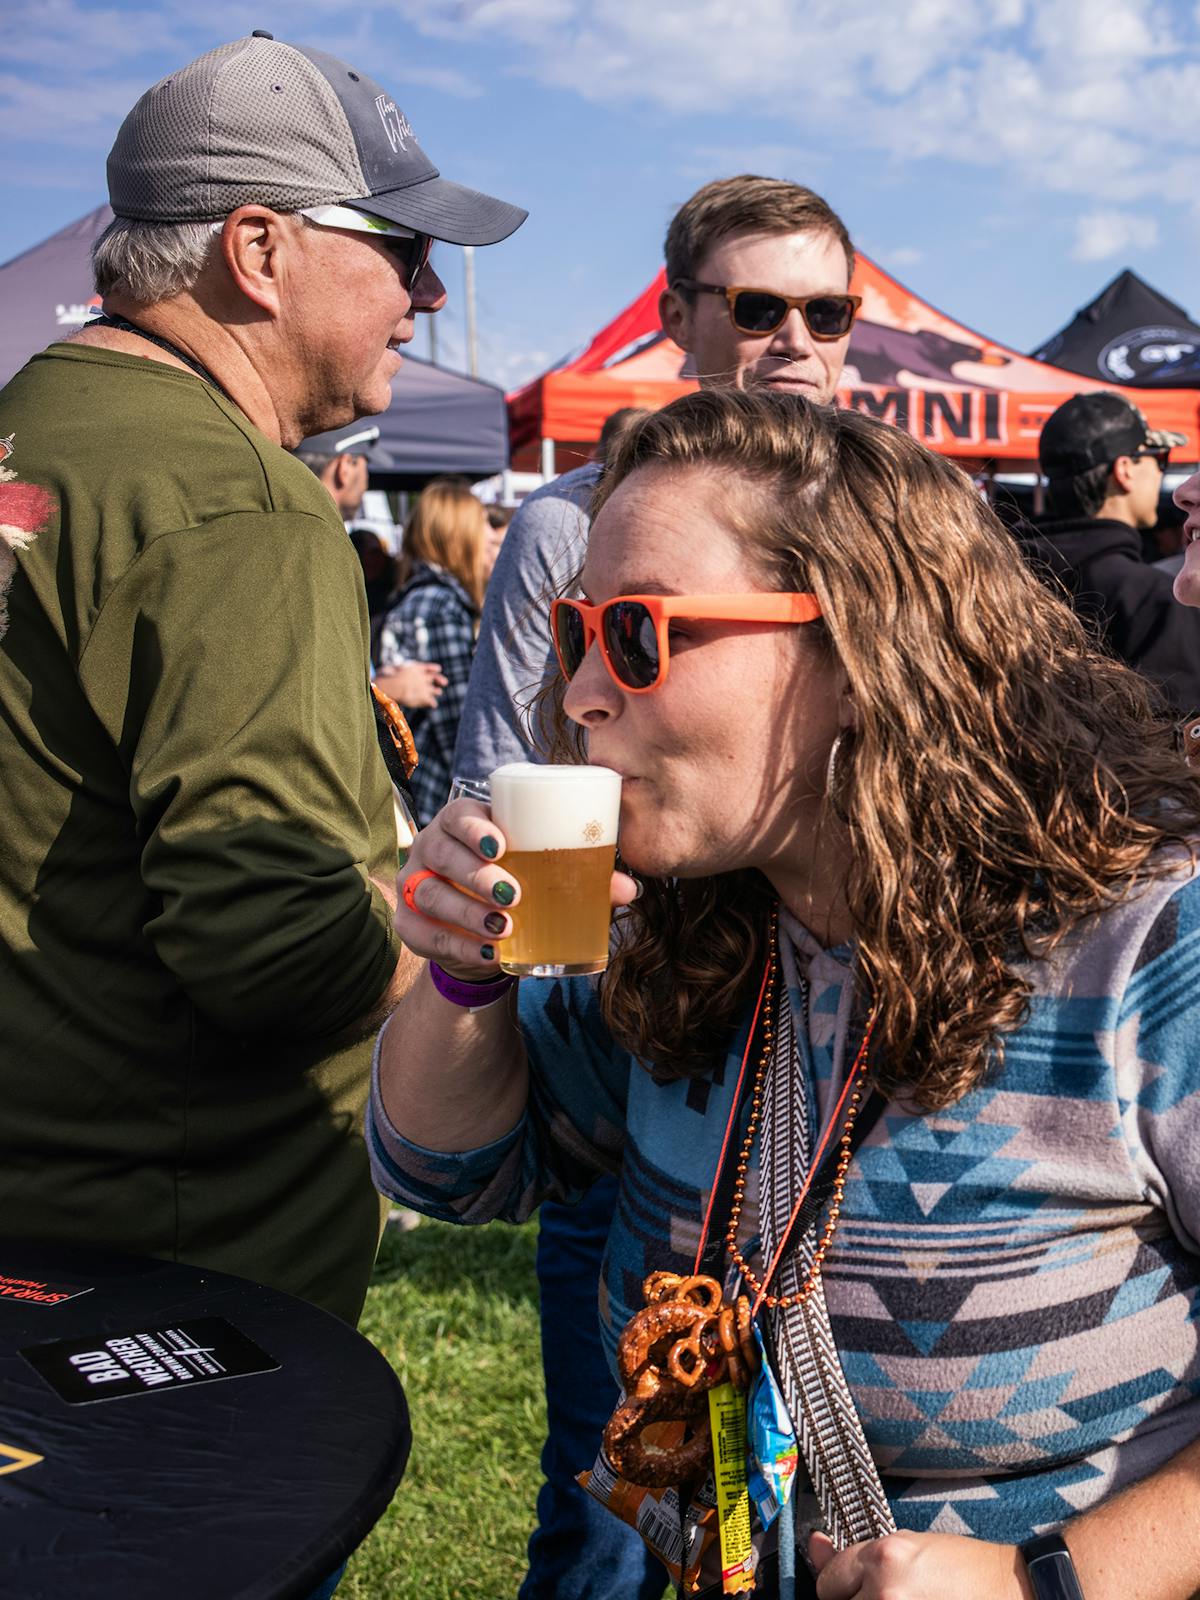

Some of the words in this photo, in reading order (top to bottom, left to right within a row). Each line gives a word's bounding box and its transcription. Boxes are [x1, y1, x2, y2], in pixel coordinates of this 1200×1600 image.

[832, 390, 1008, 444] MNI
[105, 1336, 174, 1386] WEATHER
[135, 1333, 166, 1357] COMPANY
[68, 1350, 130, 1384] BAD
[160, 1355, 194, 1380] BREWING
